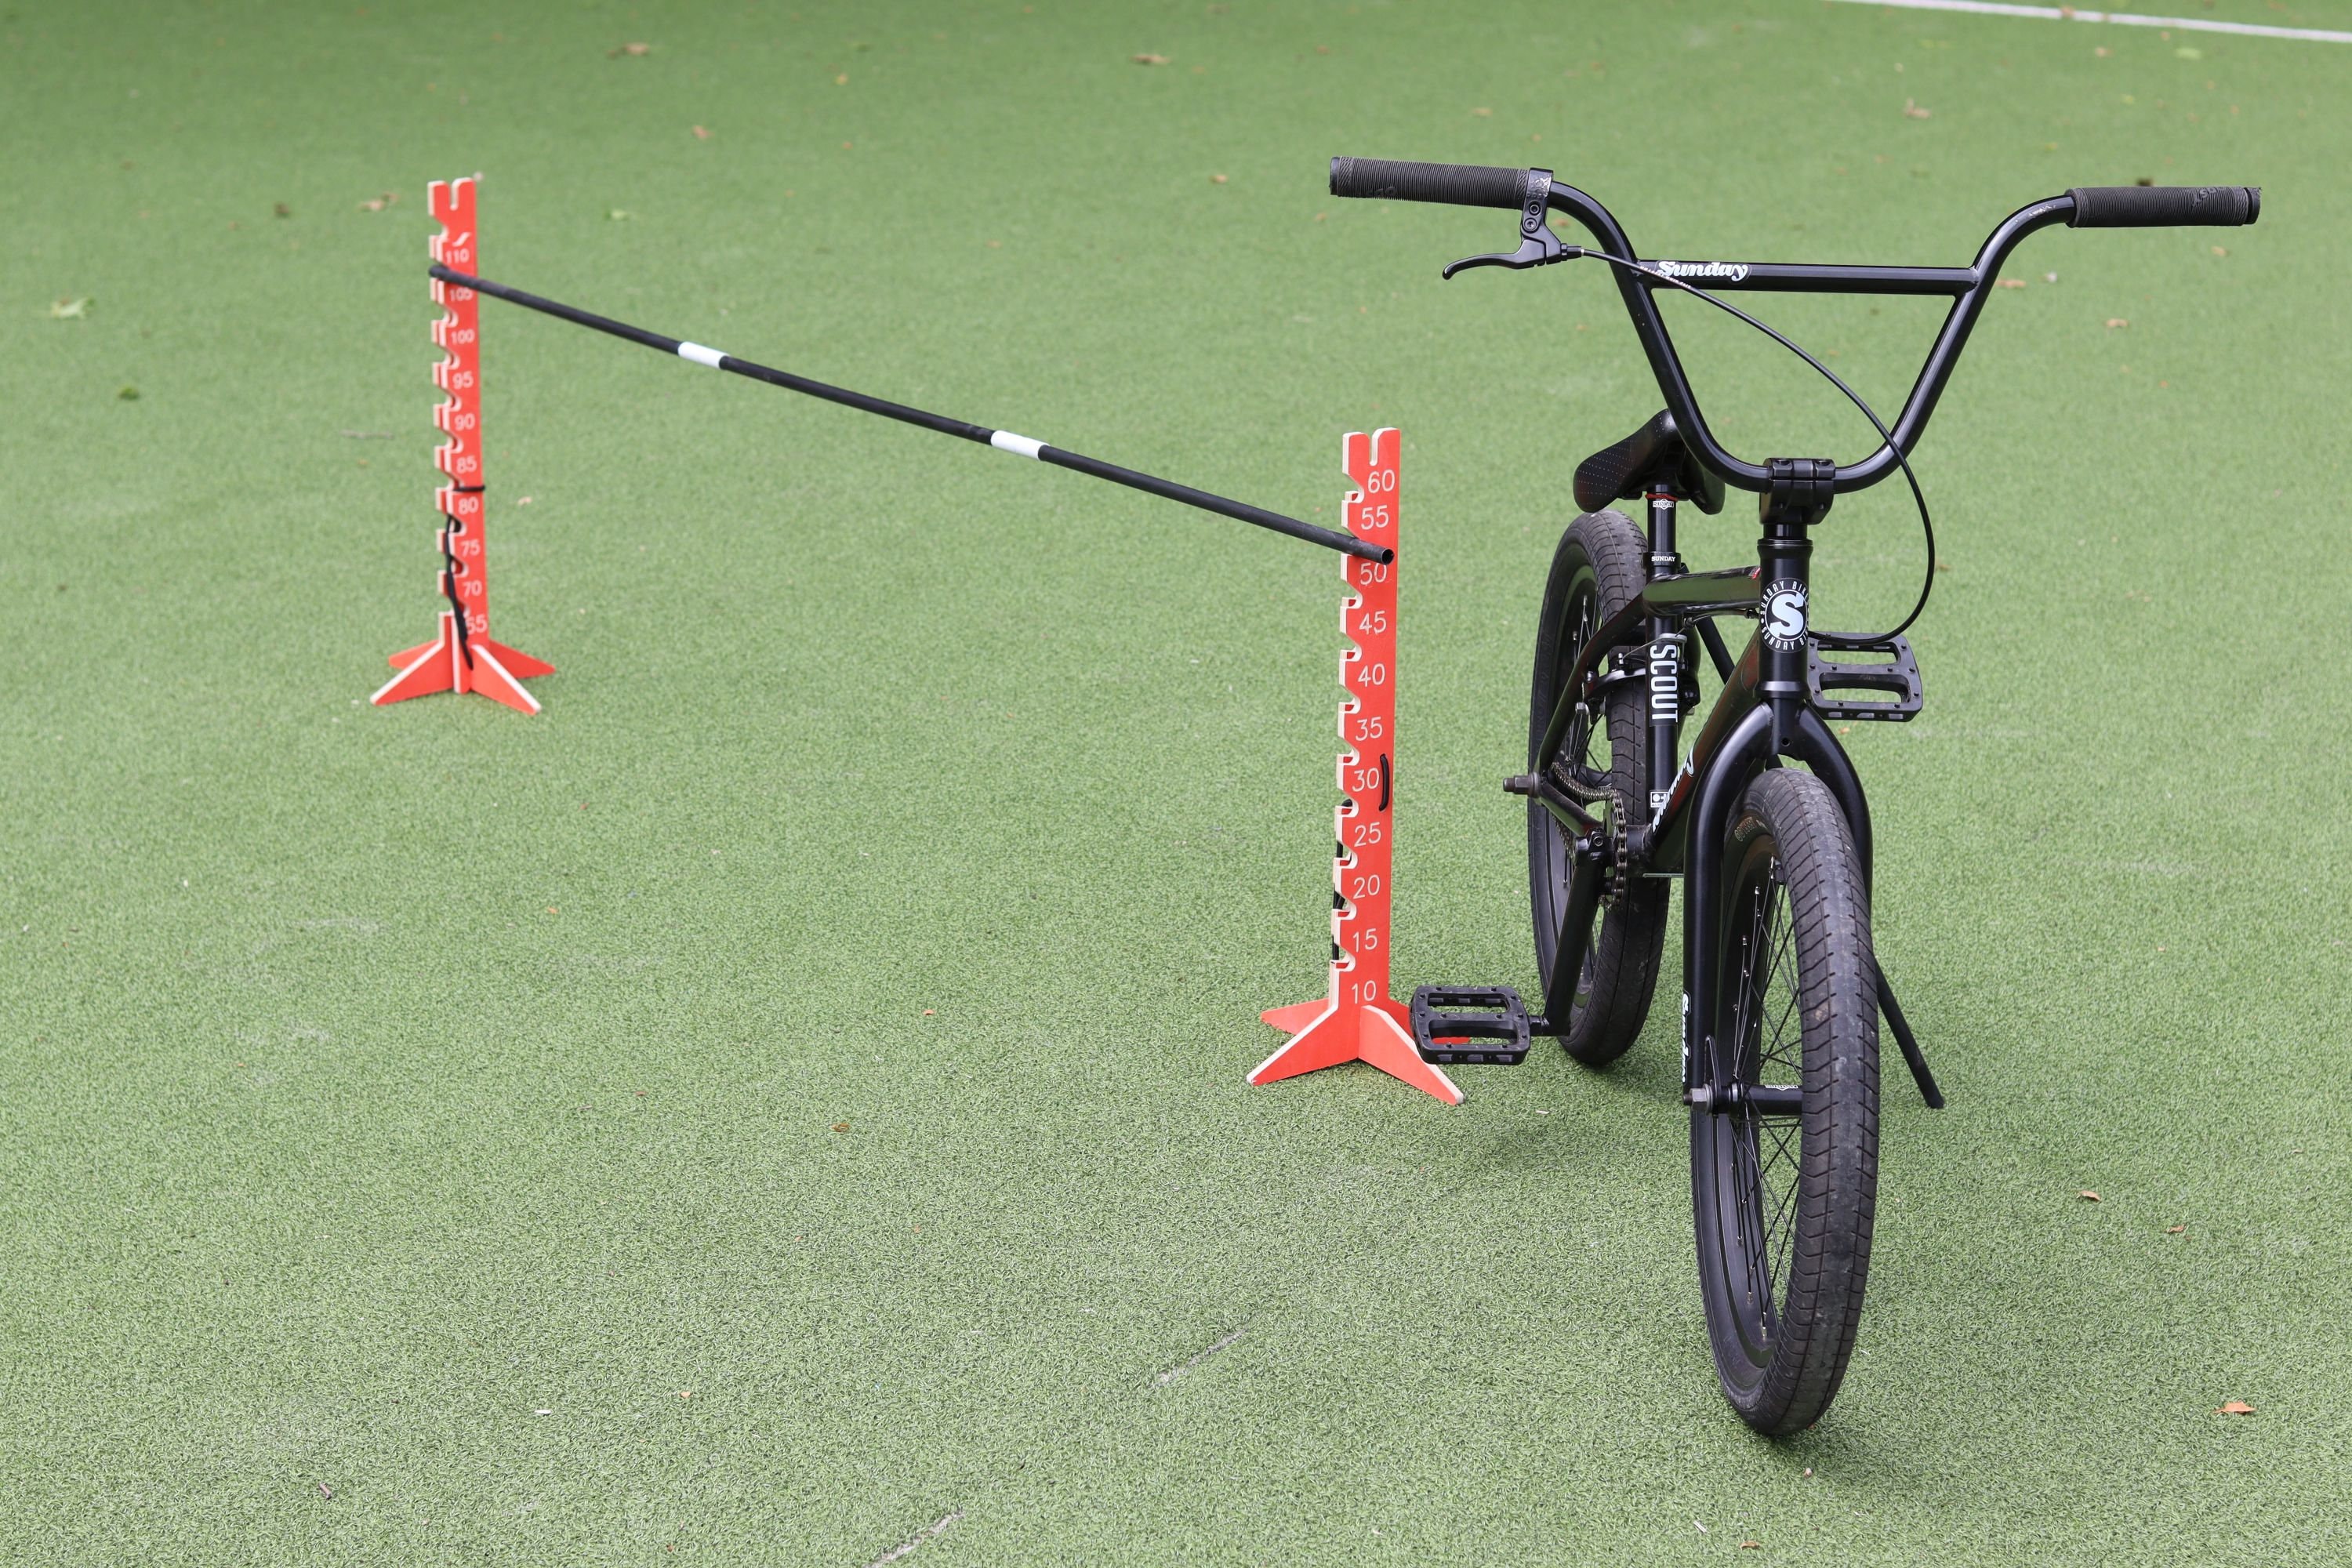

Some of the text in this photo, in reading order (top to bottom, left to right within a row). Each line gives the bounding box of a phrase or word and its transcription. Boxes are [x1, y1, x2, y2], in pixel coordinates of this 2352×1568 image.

[446, 249, 470, 263] 110
[1657, 260, 1748, 282] Sunday
[449, 287, 474, 302] 105
[451, 328, 475, 345] 100
[452, 370, 474, 390] 95
[455, 412, 476, 430] 90
[456, 455, 477, 474] 85
[1367, 469, 1396, 493] 60
[458, 496, 479, 515] 80
[1360, 504, 1389, 530] 55
[460, 539, 481, 557] 75
[1360, 562, 1388, 586] 50
[463, 579, 483, 597] 70
[1760, 580, 1784, 615] SUNDAY
[1359, 610, 1387, 635] 45
[1761, 626, 1795, 651] SUNDAY
[1357, 663, 1385, 688] 40
[1650, 644, 1679, 723] SCOUT
[1355, 716, 1383, 742] 35
[1352, 767, 1380, 793] 30
[1354, 821, 1381, 848] 25
[1352, 874, 1381, 899] 20
[1352, 927, 1377, 953] 15
[1351, 980, 1377, 1004] 10
